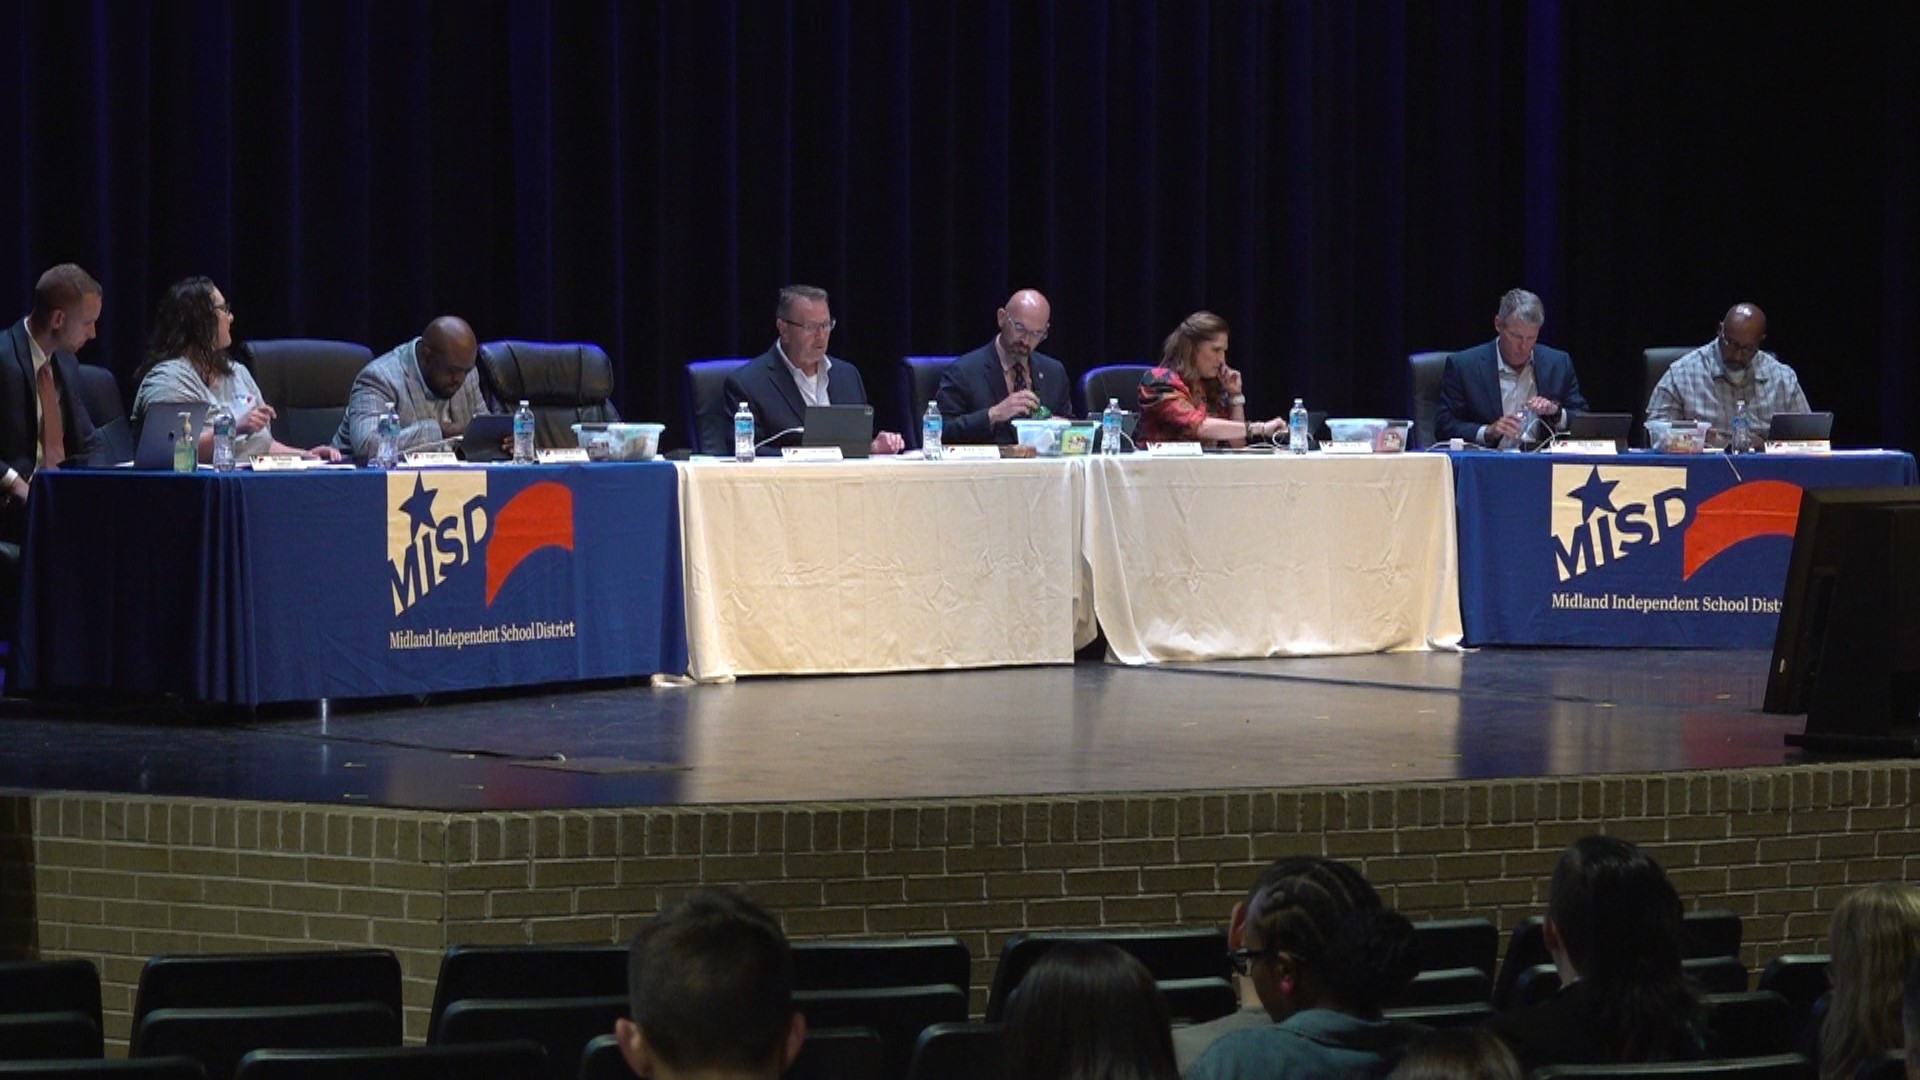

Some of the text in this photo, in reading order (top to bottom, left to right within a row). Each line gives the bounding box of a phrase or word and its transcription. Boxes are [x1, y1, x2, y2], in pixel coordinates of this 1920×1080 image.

[388, 494, 490, 617] MISD
[1551, 487, 1688, 582] MISD
[1552, 592, 1609, 610] Midland
[1612, 594, 1699, 613] Independent
[1702, 596, 1749, 612] School
[389, 620, 576, 650] Midland Independent School District
